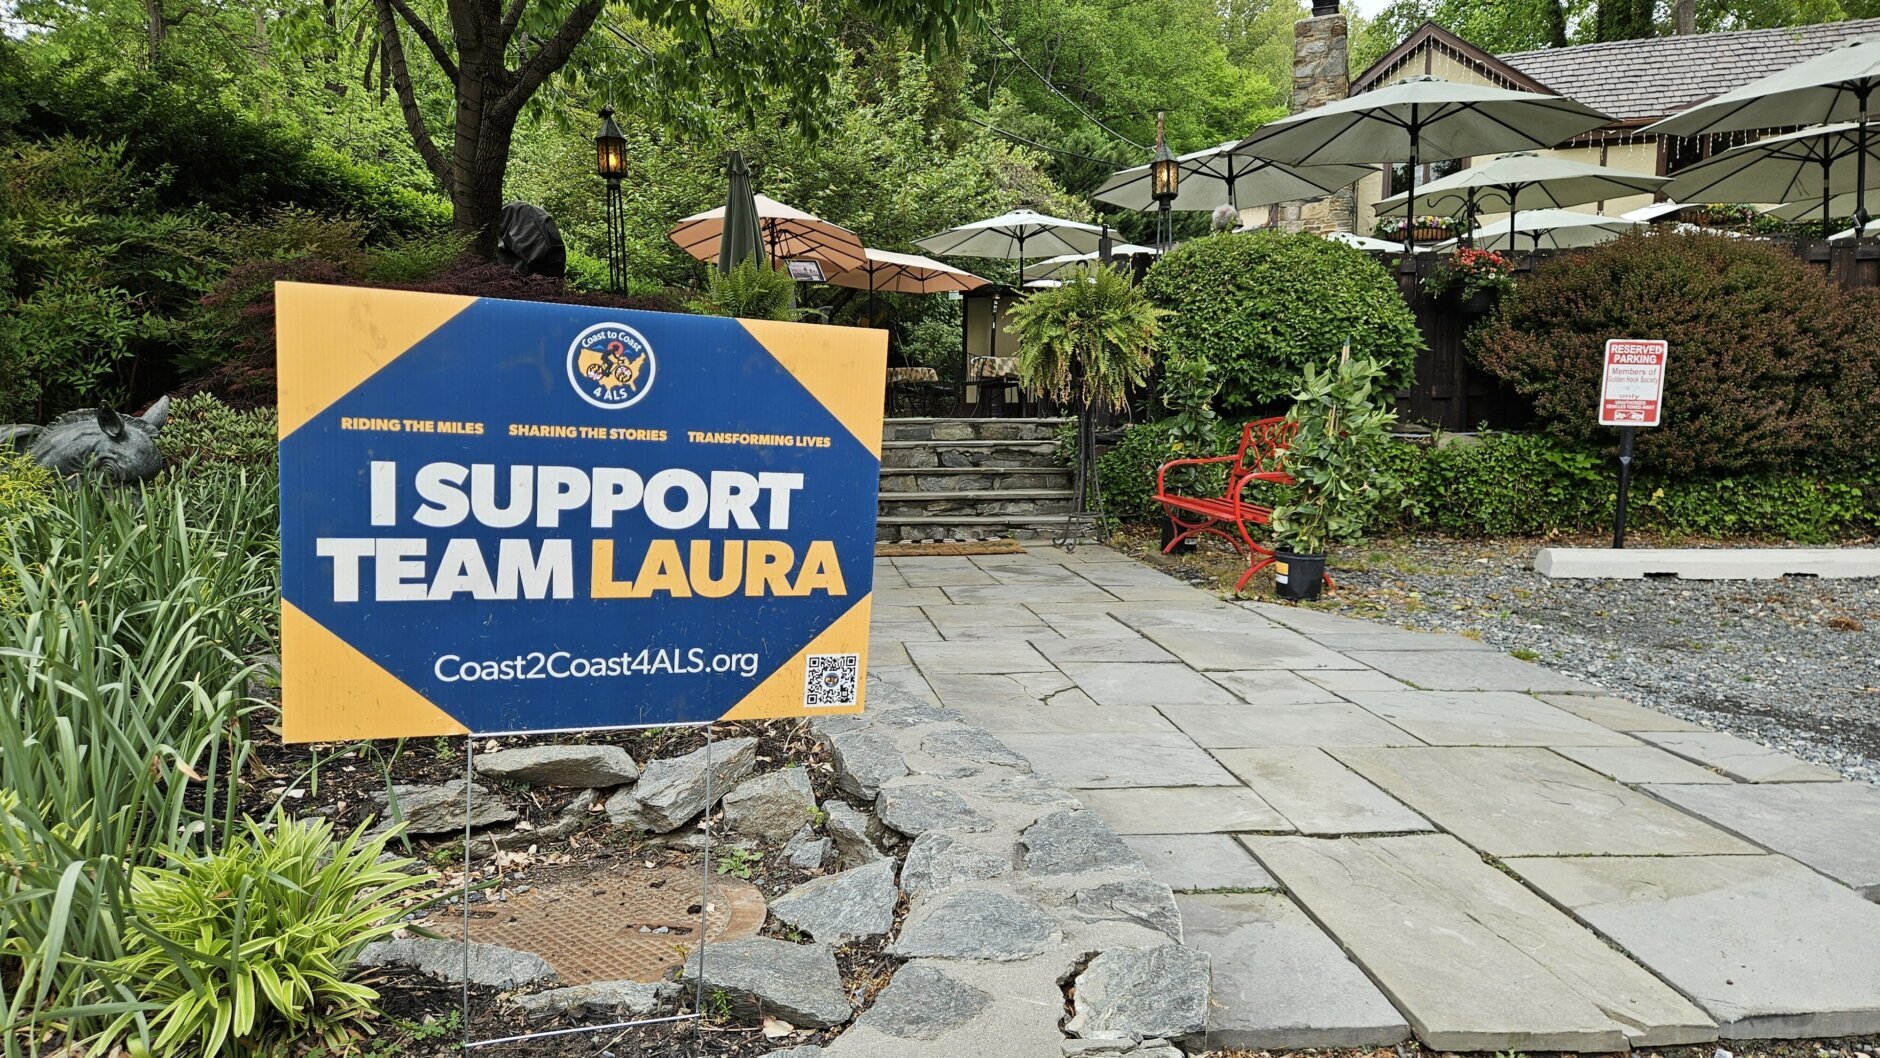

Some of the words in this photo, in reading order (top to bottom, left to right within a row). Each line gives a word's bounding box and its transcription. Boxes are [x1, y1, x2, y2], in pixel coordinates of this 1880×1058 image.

[581, 330, 606, 347] Coast
[607, 330, 617, 339] to
[618, 332, 642, 352] Coast
[1611, 344, 1663, 354] RESERVED
[1614, 354, 1657, 364] PARKING
[1612, 367, 1647, 376] Members
[1648, 368, 1657, 376] of
[593, 387, 602, 397] 4
[604, 388, 627, 400] ALS
[341, 417, 400, 431] RIDING
[403, 419, 434, 432] THE
[437, 421, 484, 434] MILES
[508, 424, 577, 438] SHARING
[579, 427, 606, 439] THE
[609, 428, 667, 441] STORIES
[688, 431, 793, 446] TRANSFORMING
[796, 436, 831, 448] LIVES
[370, 460, 396, 527] I
[412, 461, 804, 530] SUPPORT
[316, 537, 574, 602] TEAM
[590, 539, 848, 599] LAURA
[434, 647, 758, 683] Coast2Coast4ALS.org
